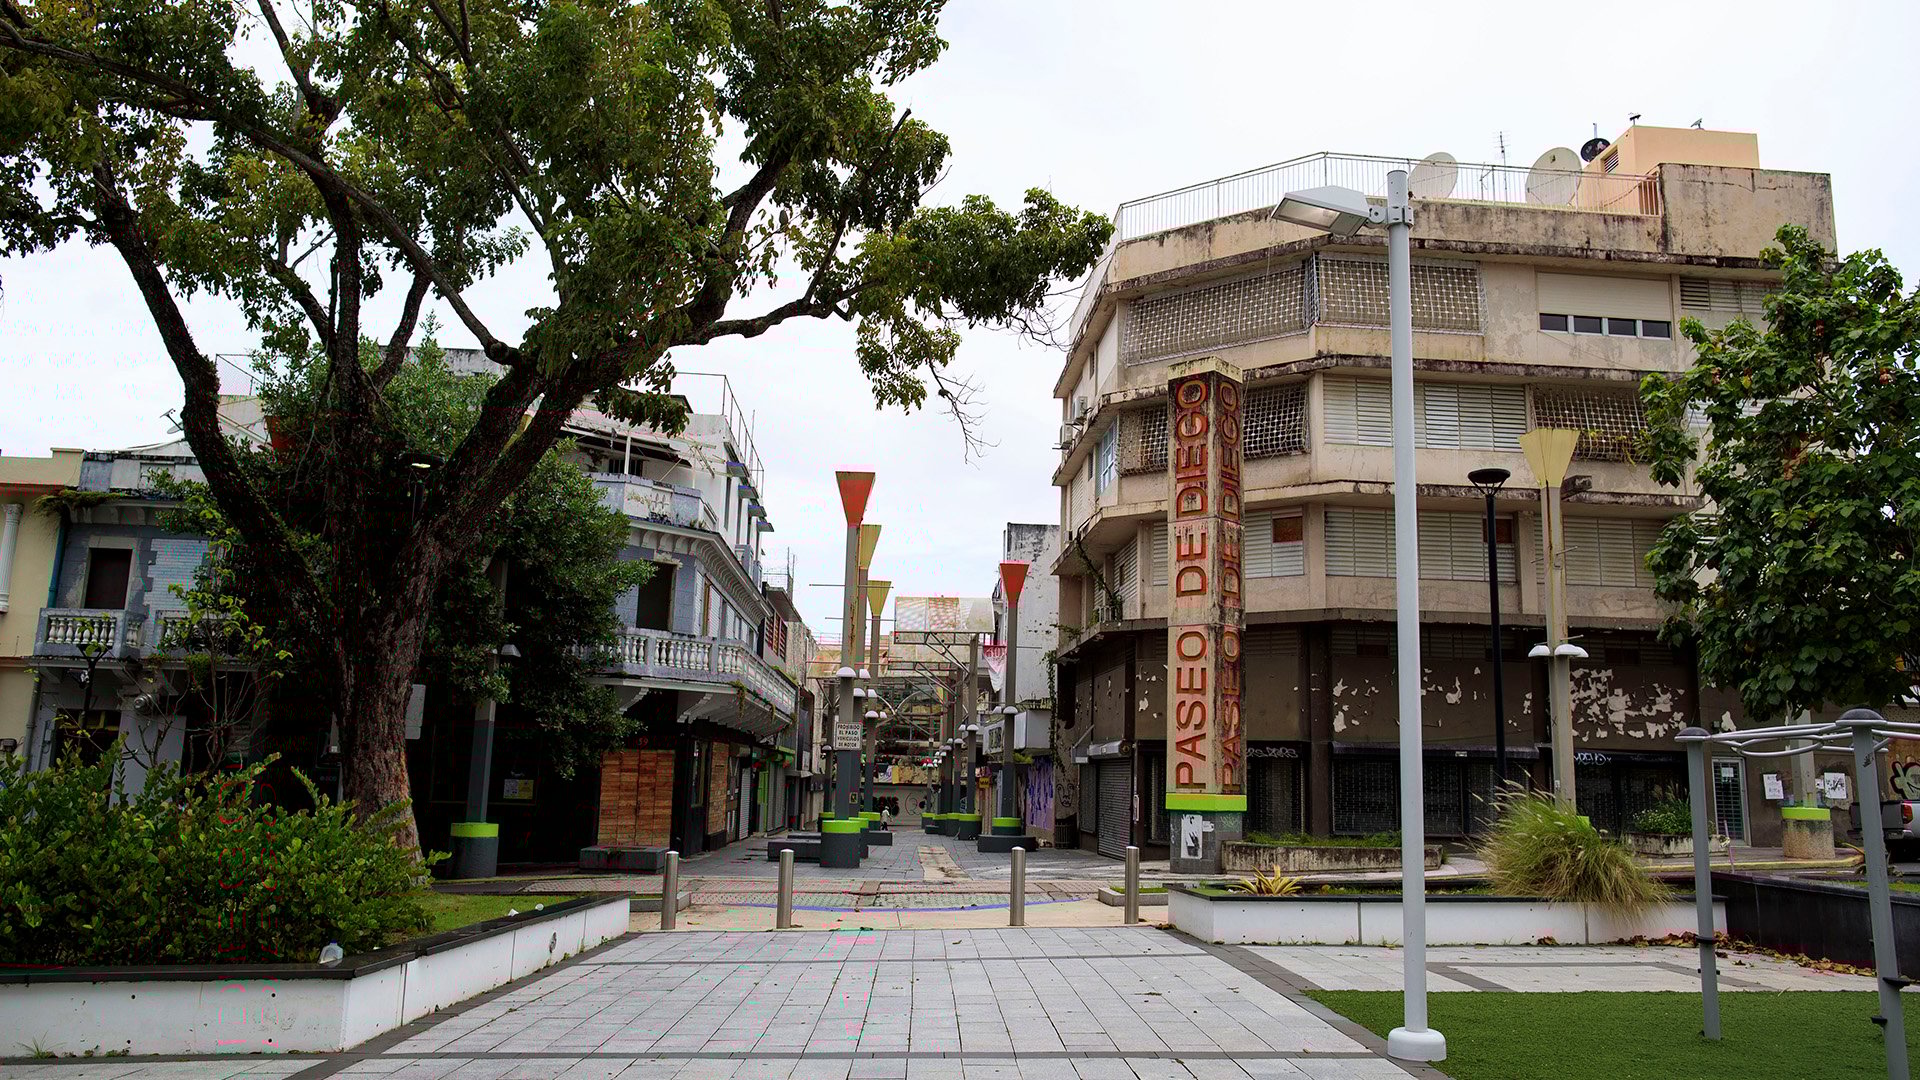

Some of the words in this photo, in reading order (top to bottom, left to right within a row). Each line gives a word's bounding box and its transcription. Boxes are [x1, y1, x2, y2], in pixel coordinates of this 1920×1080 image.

[1176, 380, 1207, 518] DIEGO
[1220, 381, 1240, 520] DIEGO
[1176, 533, 1206, 597] DE
[1221, 533, 1240, 600] DE
[1176, 630, 1207, 789] PASEO
[1221, 630, 1241, 791] PASEO
